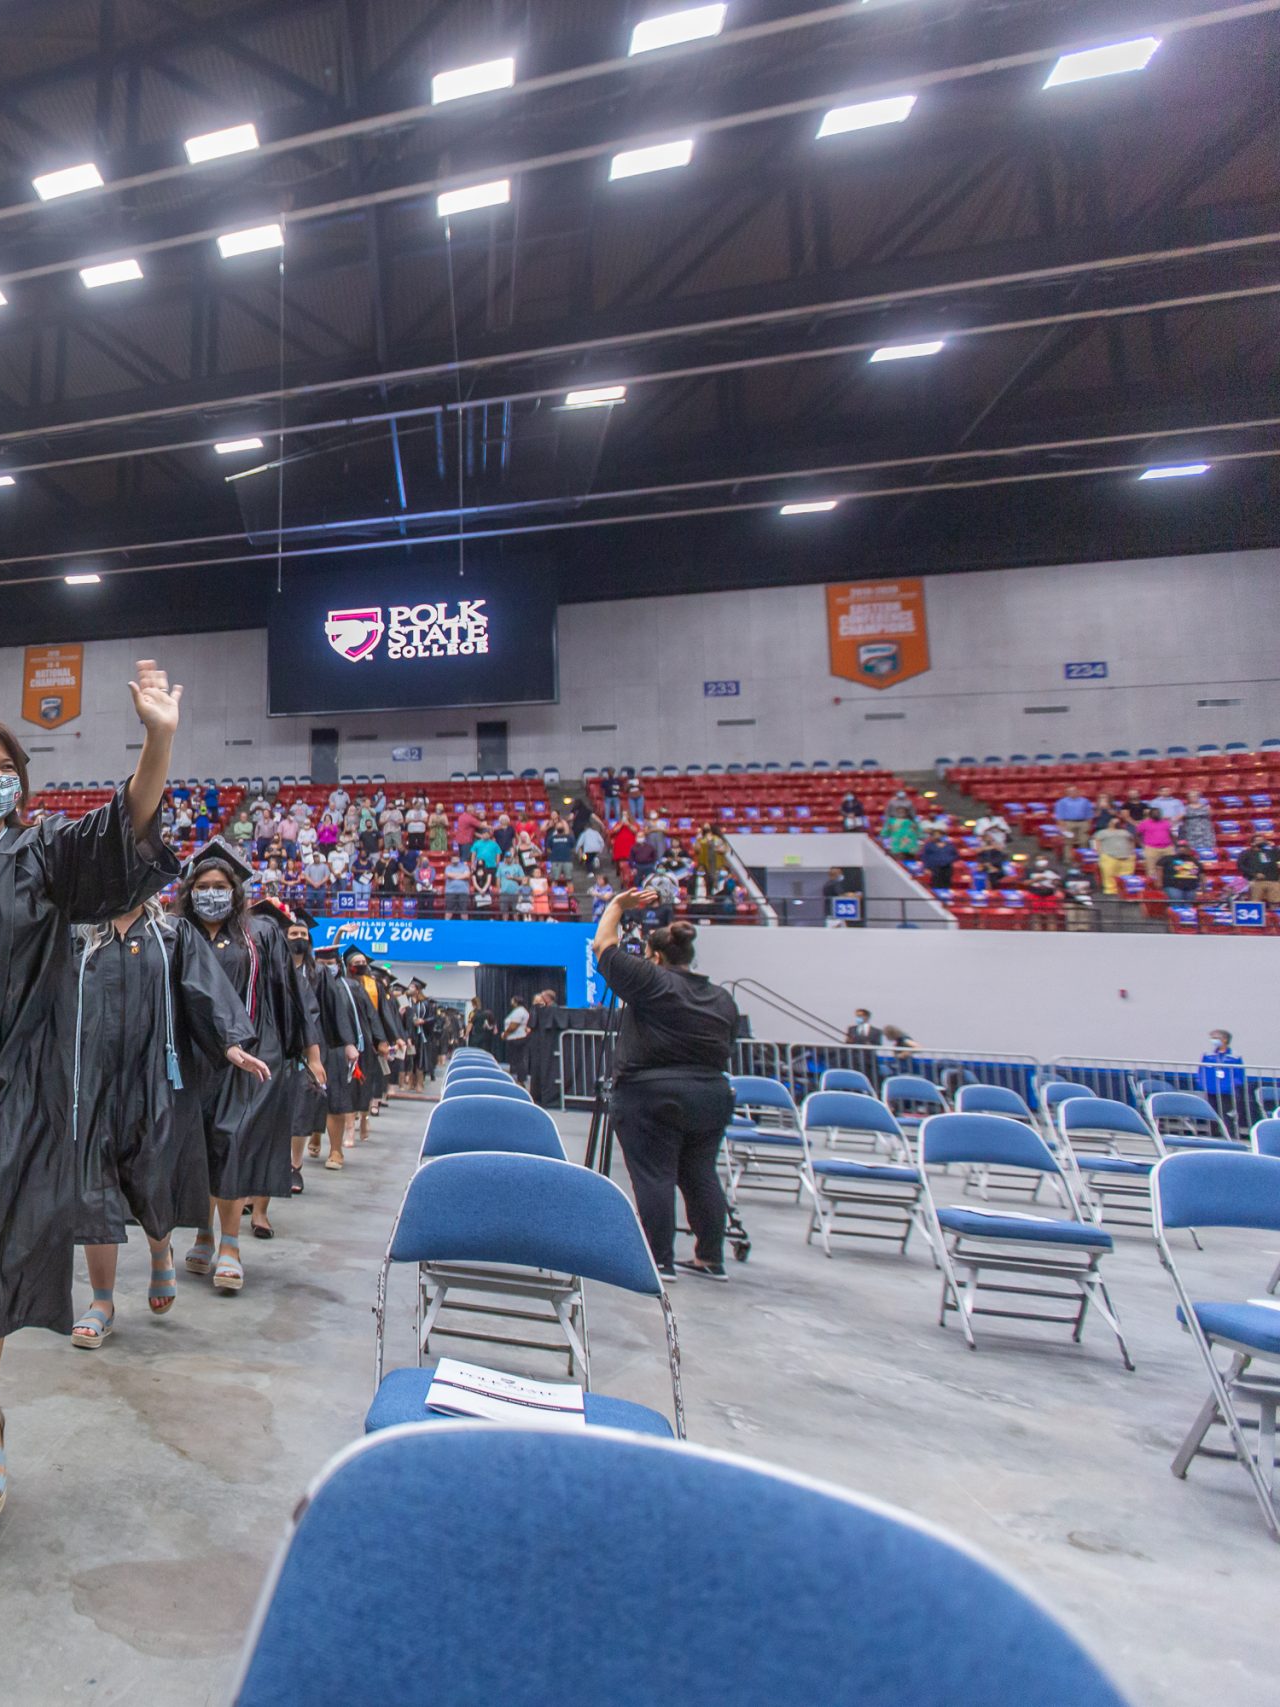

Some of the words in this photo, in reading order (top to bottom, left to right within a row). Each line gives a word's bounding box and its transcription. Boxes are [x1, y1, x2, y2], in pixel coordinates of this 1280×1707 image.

[388, 599, 488, 628] POLK
[388, 620, 488, 649] STATE
[388, 641, 489, 660] COLLEGE
[707, 682, 737, 695] 233
[341, 897, 354, 907] 32
[838, 903, 856, 915] 33
[1237, 908, 1260, 920] 34
[390, 928, 435, 942] ZONE
